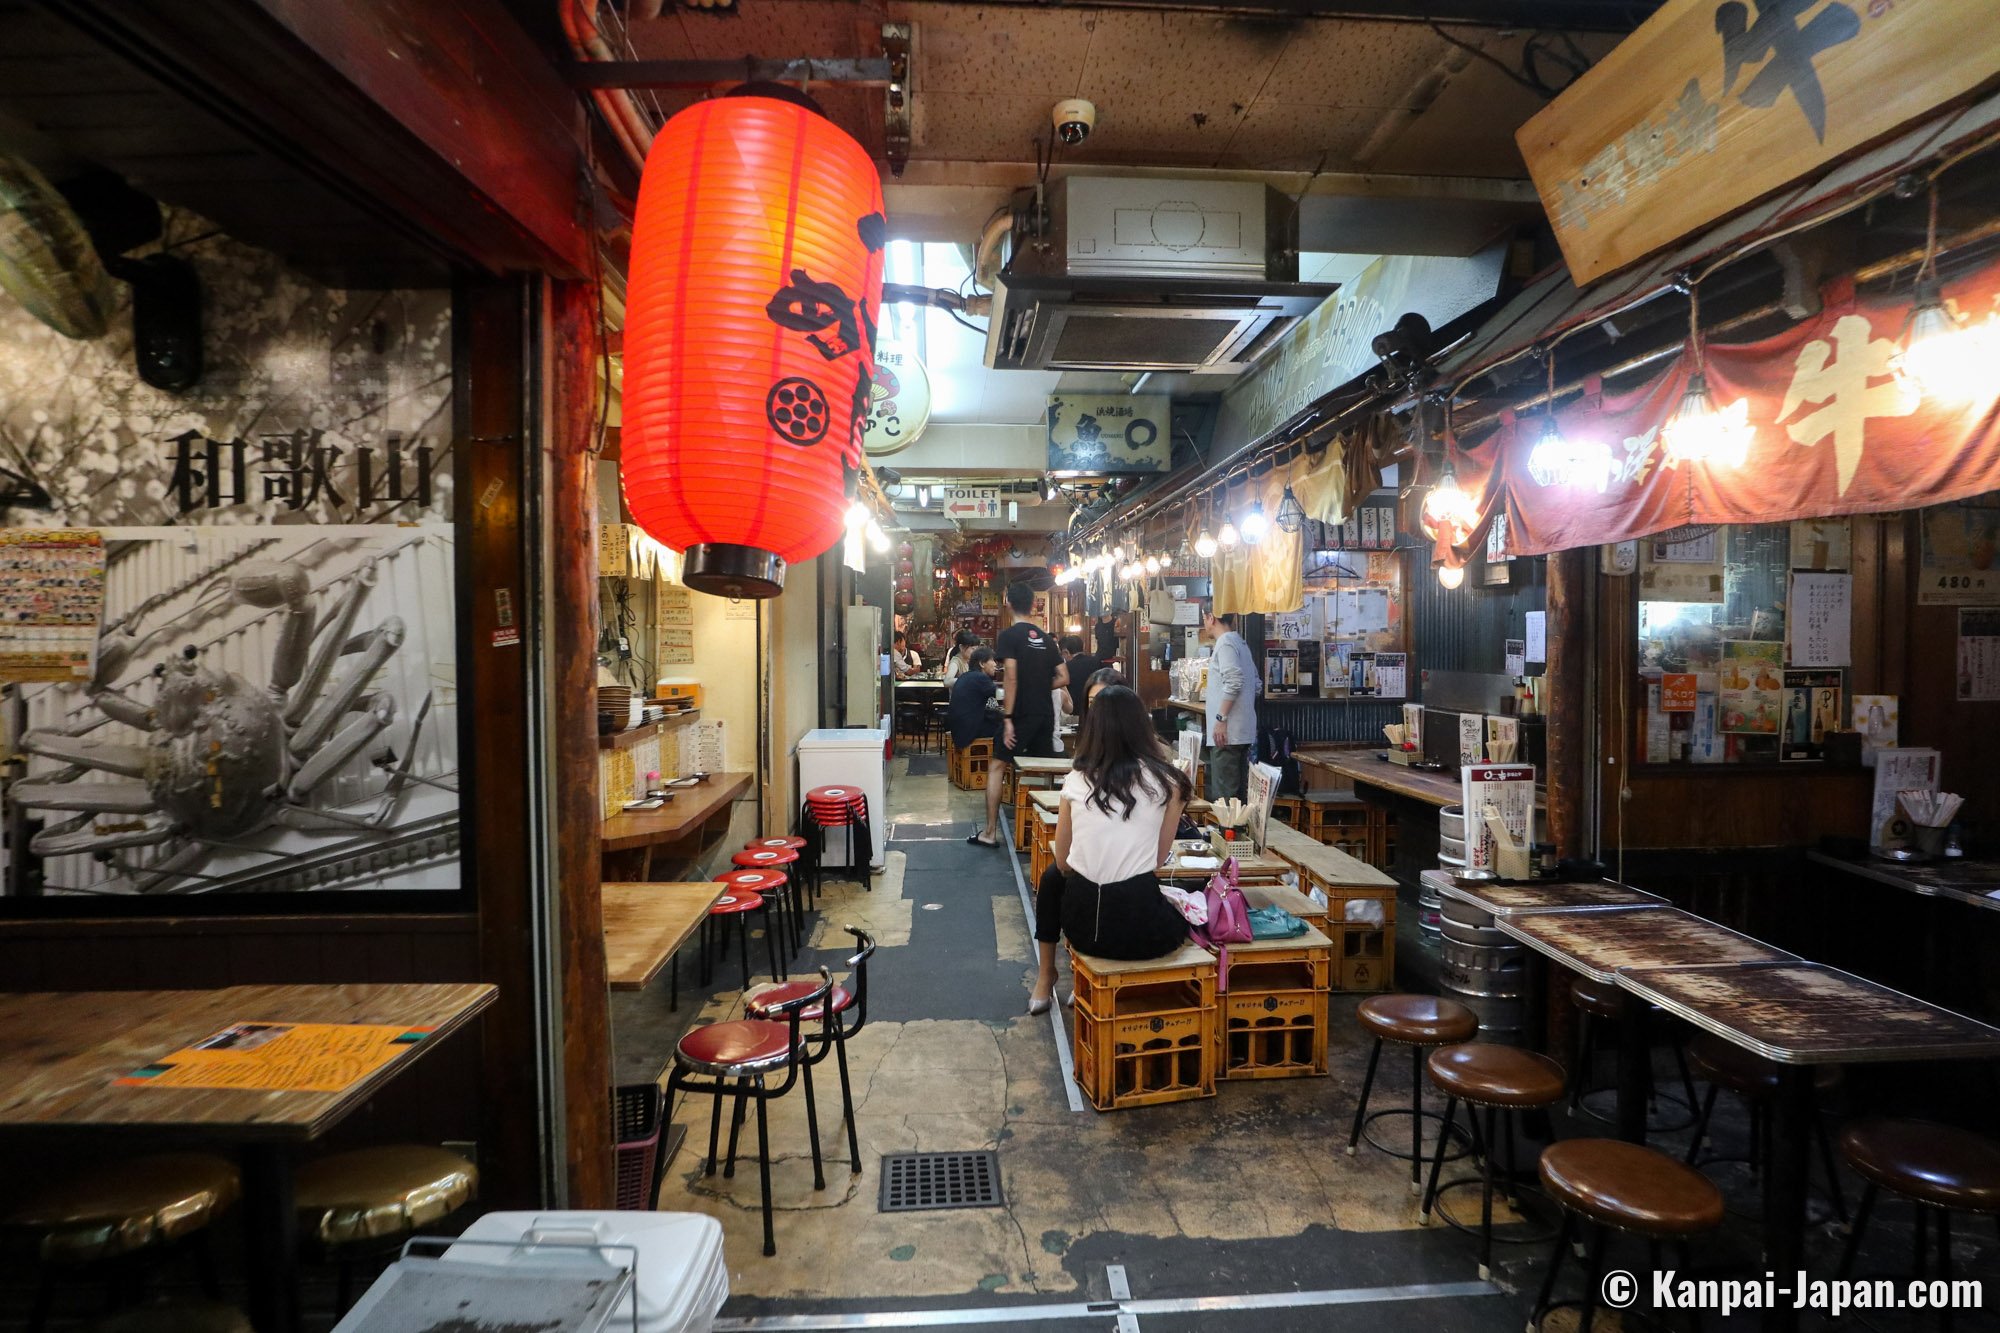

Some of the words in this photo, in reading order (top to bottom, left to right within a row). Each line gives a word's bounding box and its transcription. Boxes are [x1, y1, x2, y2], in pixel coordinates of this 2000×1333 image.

[1715, 0, 1862, 146] 牛
[1775, 314, 1921, 498] 牛
[164, 428, 434, 514] 和歌山
[947, 489, 998, 499] TOILET
[1937, 575, 1971, 589] 480
[1663, 688, 1695, 699] 食べログ
